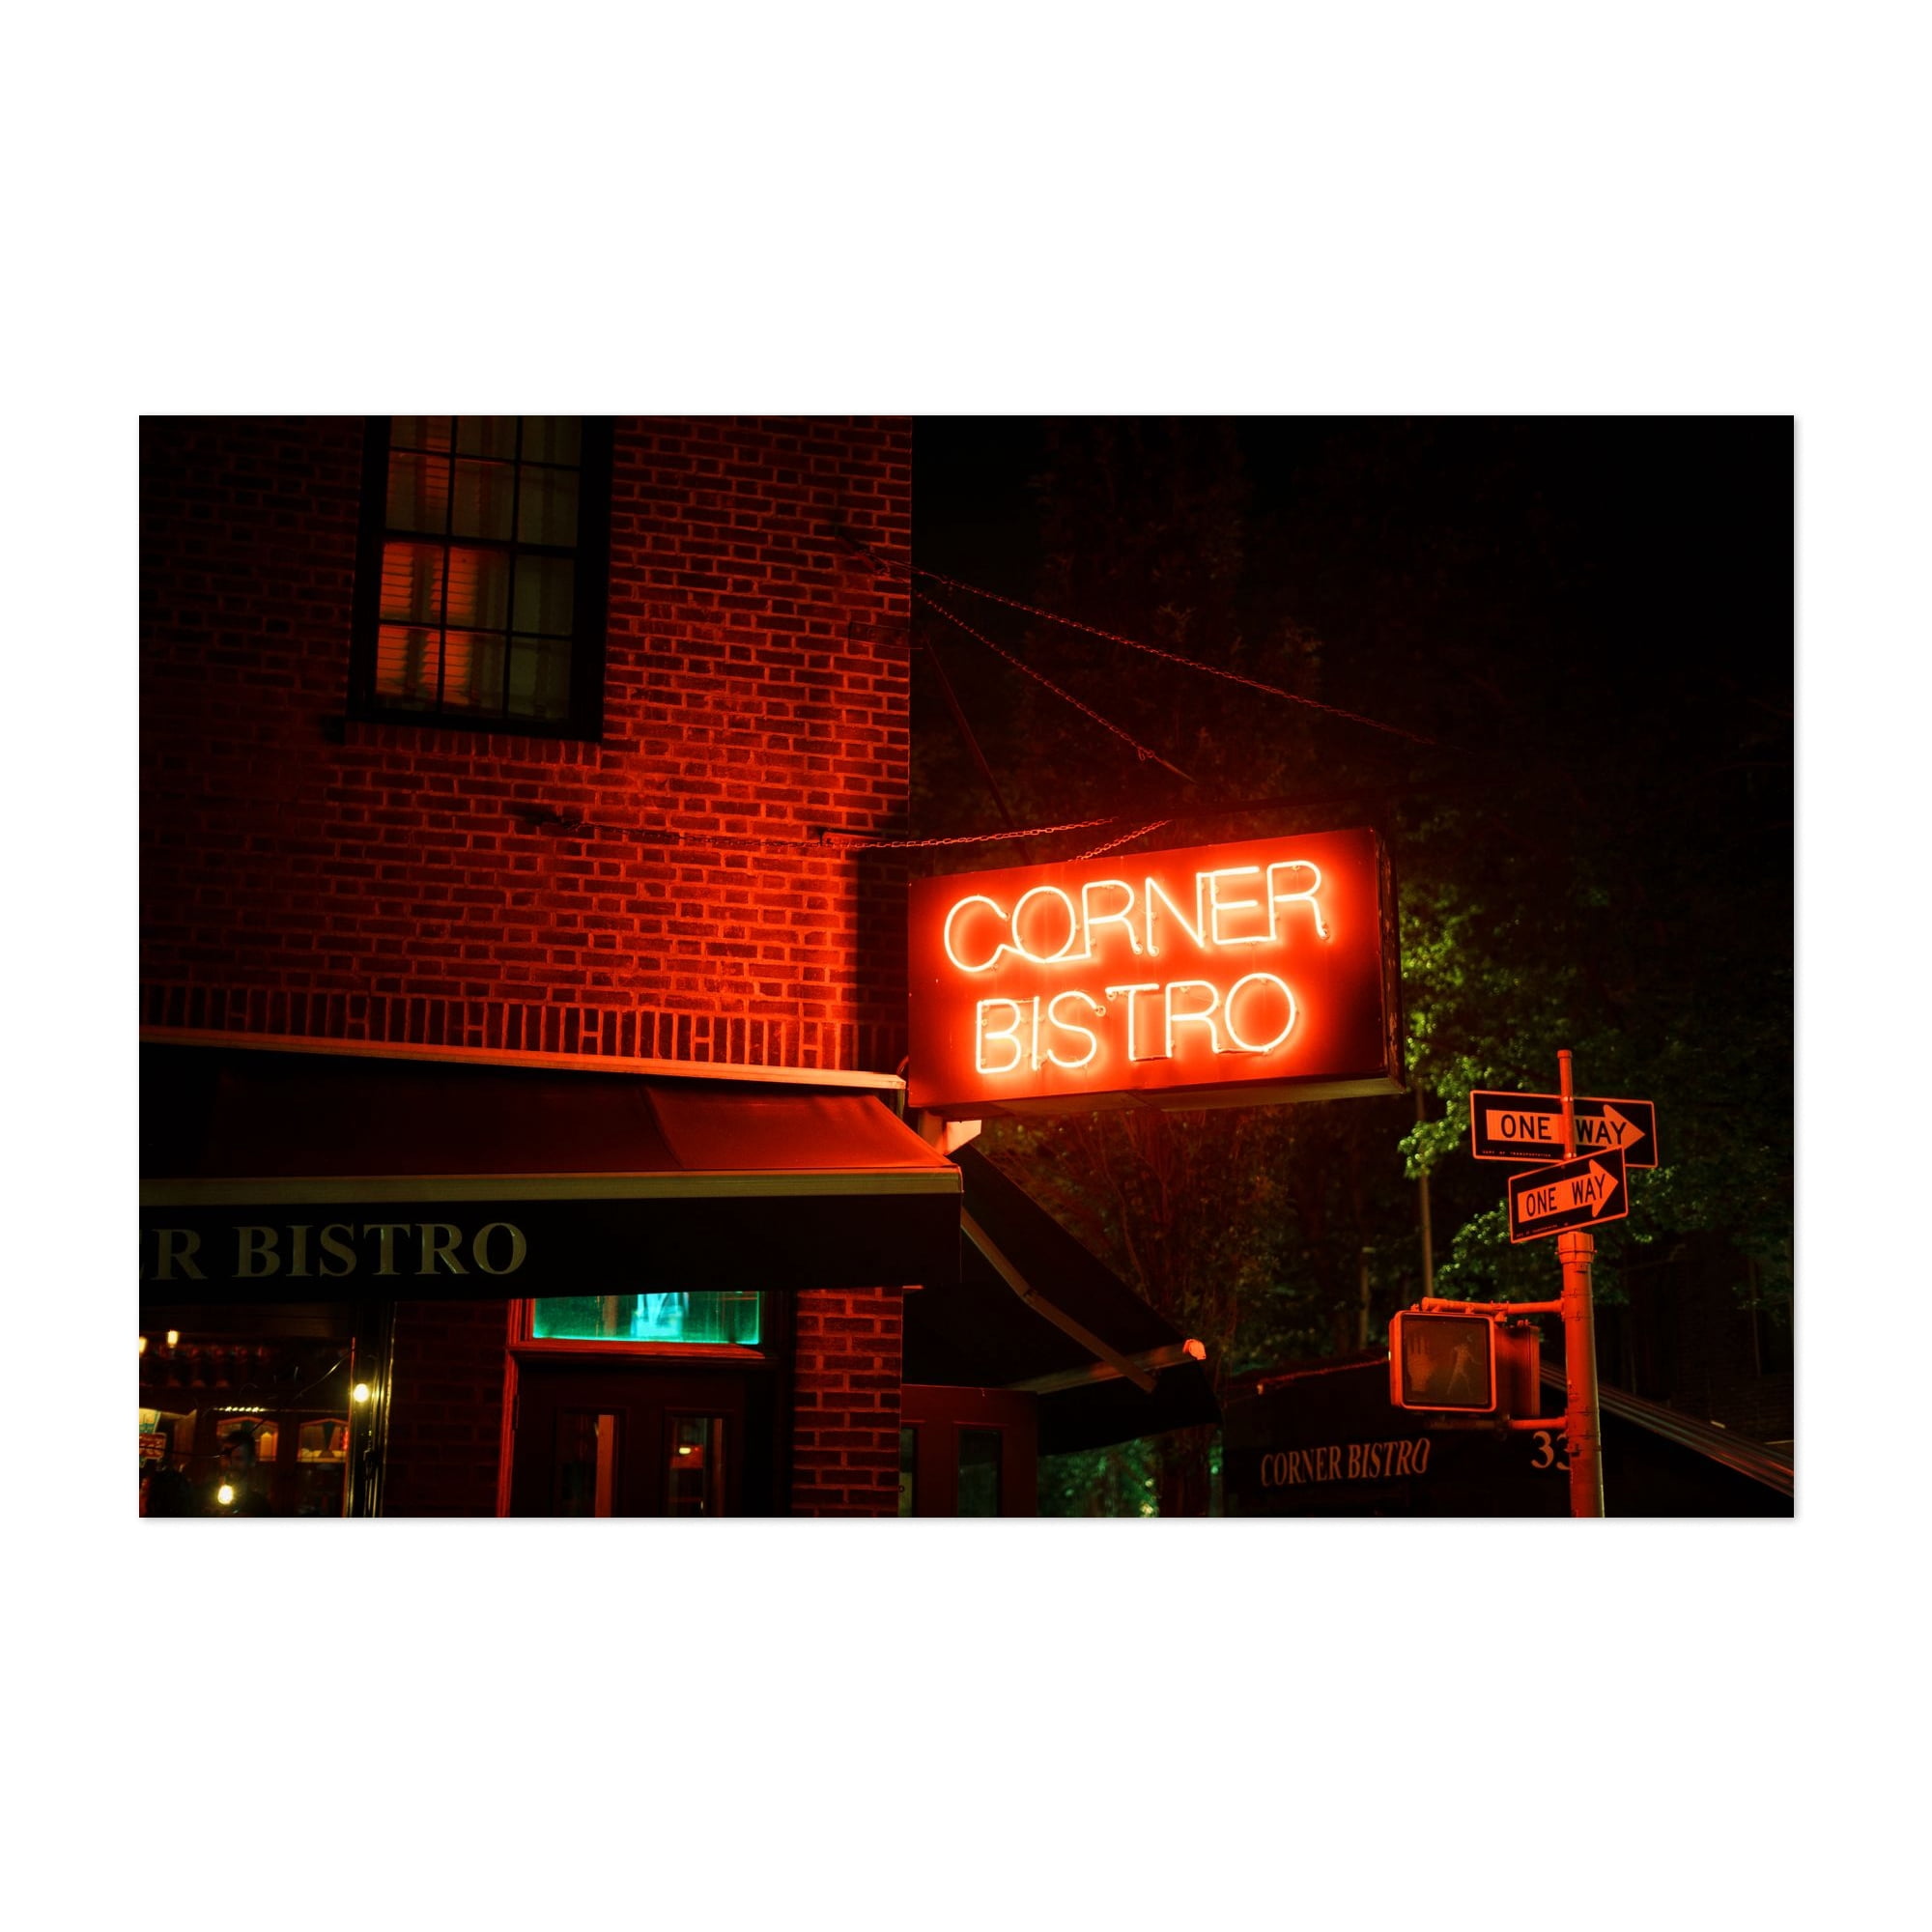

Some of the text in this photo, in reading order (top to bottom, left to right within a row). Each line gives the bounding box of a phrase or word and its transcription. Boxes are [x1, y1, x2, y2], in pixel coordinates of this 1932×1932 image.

[943, 859, 1331, 973] CORNER
[975, 972, 1297, 1074] BISTRO
[1500, 1114, 1627, 1145] ONE WAY
[1525, 1174, 1606, 1217] ONE WAY
[139, 1221, 528, 1281] R BISTRO
[1260, 1436, 1432, 1489] CORNER BISTRO
